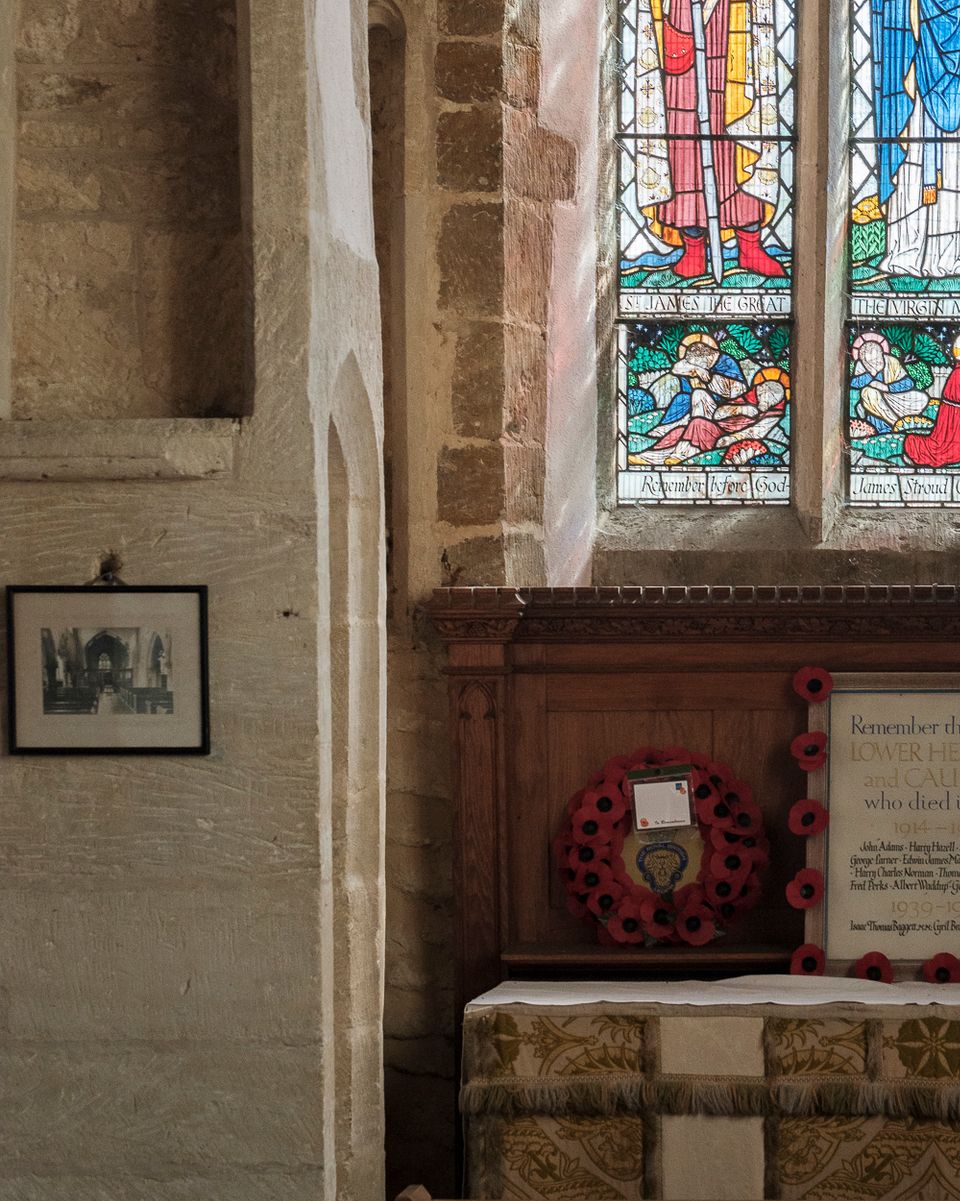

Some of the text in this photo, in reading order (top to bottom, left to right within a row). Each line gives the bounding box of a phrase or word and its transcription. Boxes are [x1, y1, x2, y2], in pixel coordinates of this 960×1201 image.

[645, 295, 700, 312] JAMES
[709, 296, 732, 312] THE
[737, 296, 787, 312] GREAT
[856, 298, 886, 315] THE
[890, 299, 945, 315] VIRGIN
[641, 475, 706, 497] Remember
[710, 474, 747, 496] before
[852, 477, 898, 495] James
[903, 477, 949, 495] Stroud
[851, 714, 940, 735] Remember
[850, 742, 924, 761] LOWER
[863, 767, 899, 788] and
[864, 790, 903, 810] who
[908, 790, 951, 810] died
[860, 841, 878, 852] John
